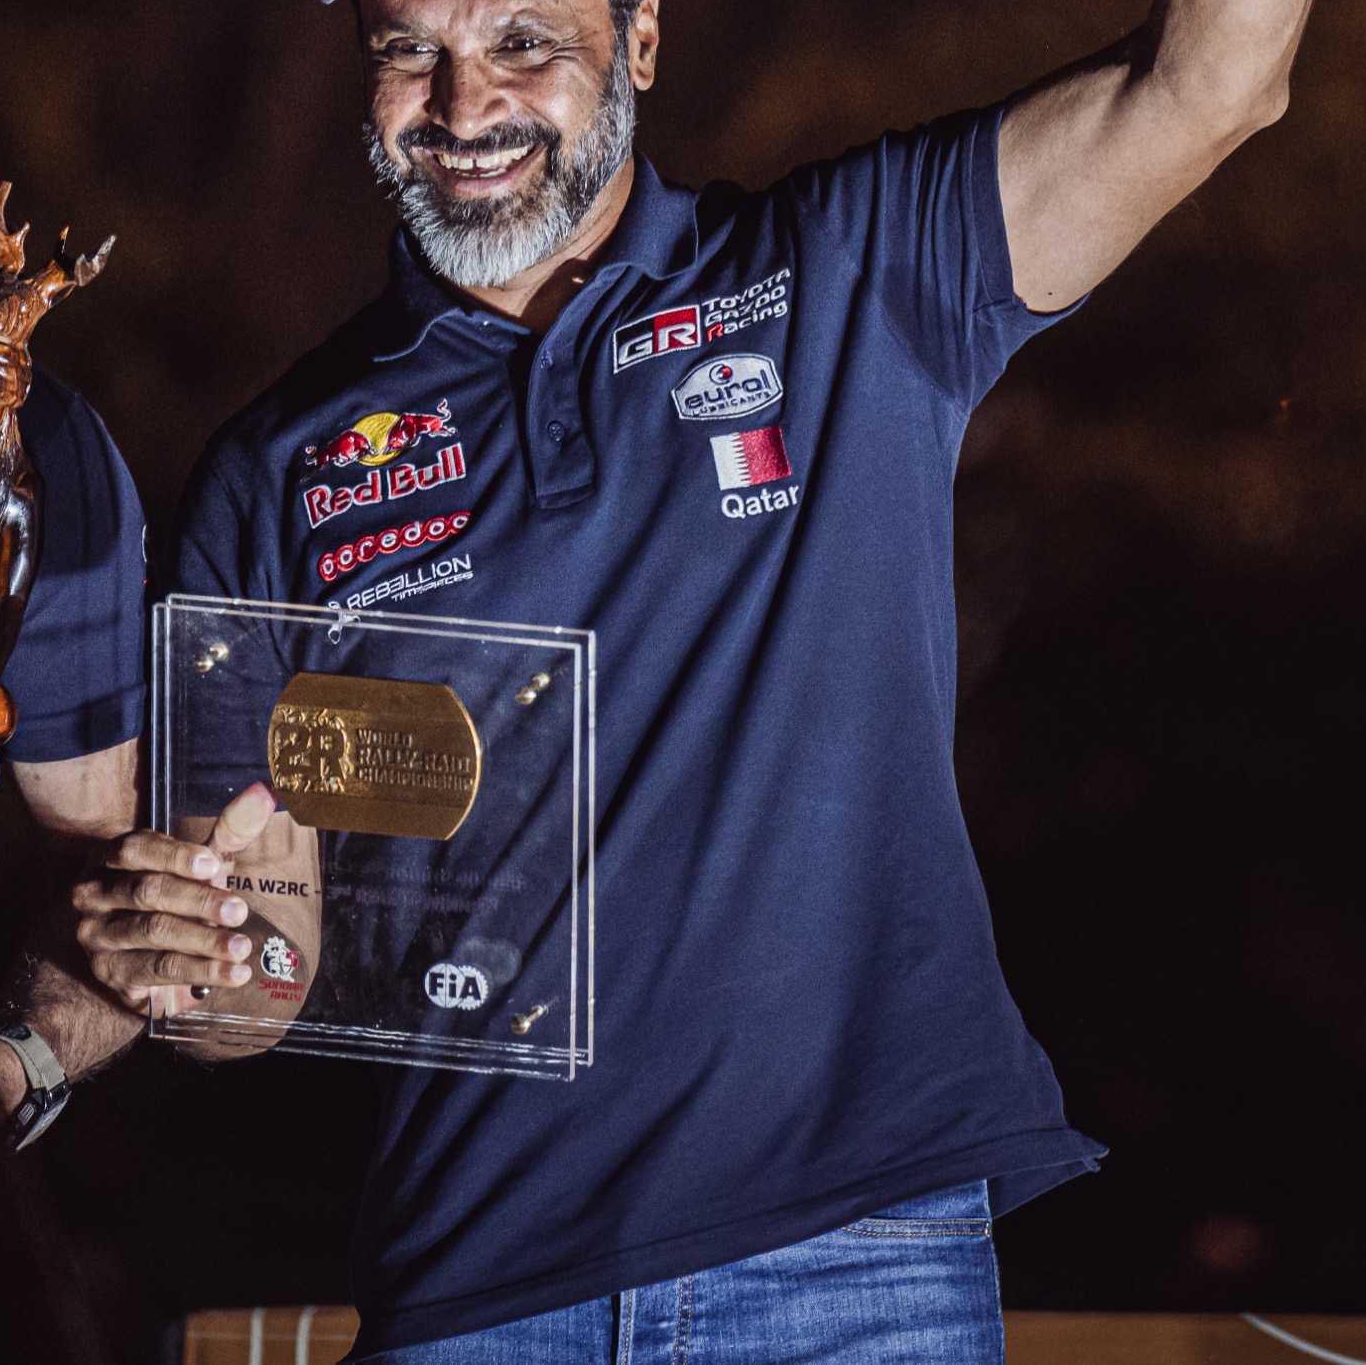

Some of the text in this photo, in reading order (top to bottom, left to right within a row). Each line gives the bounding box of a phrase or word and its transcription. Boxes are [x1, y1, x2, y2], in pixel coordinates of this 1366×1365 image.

[701, 267, 791, 312] TOYOTA
[704, 285, 786, 328] GAZOO
[706, 300, 788, 343] Racing
[685, 369, 771, 409] eurol
[304, 442, 466, 529] Red Bull
[721, 484, 799, 519] Qatar
[320, 513, 470, 580] ooredoo
[226, 875, 254, 892] FIA
[258, 878, 309, 897] W2RC
